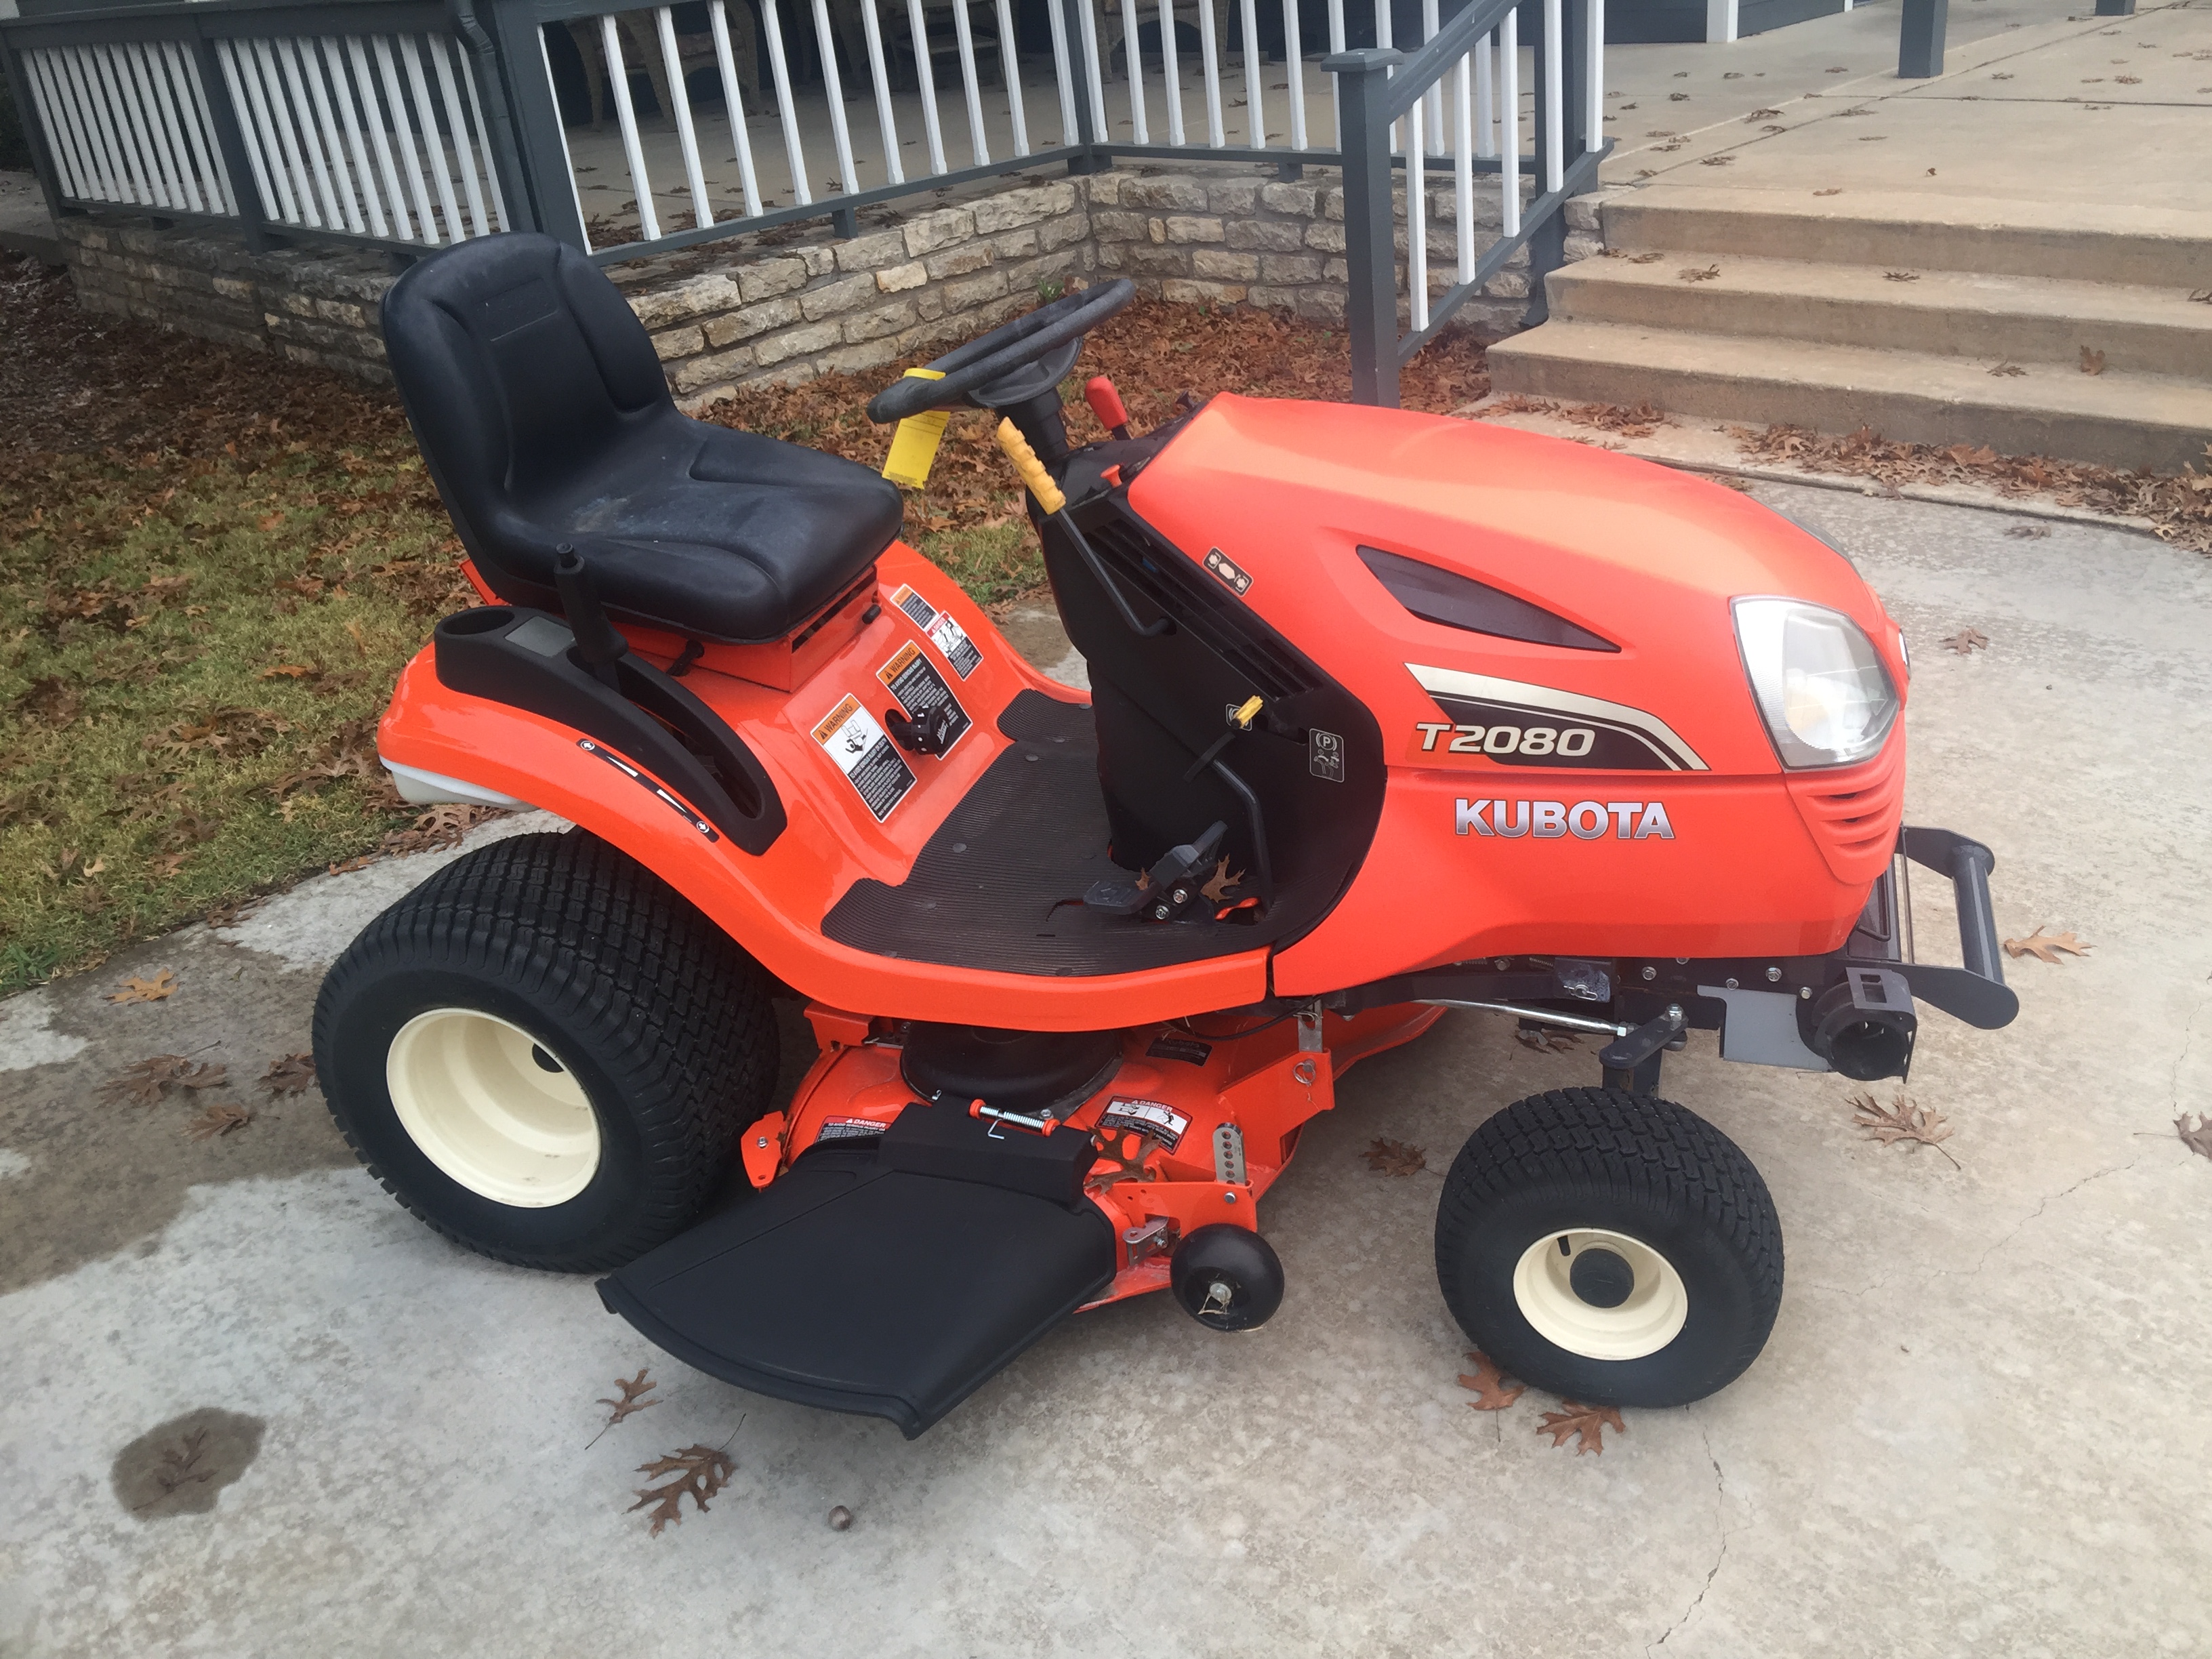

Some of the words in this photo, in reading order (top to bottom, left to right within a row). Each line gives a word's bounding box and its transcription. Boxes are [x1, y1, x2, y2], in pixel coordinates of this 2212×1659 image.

[889, 646, 916, 674] WARNING
[823, 701, 853, 734] WARNING
[1416, 722, 1596, 757] T2080
[1456, 798, 1676, 839] KUBOTA
[1139, 1100, 1173, 1112] DANGER
[853, 1119, 886, 1128] DANGER
